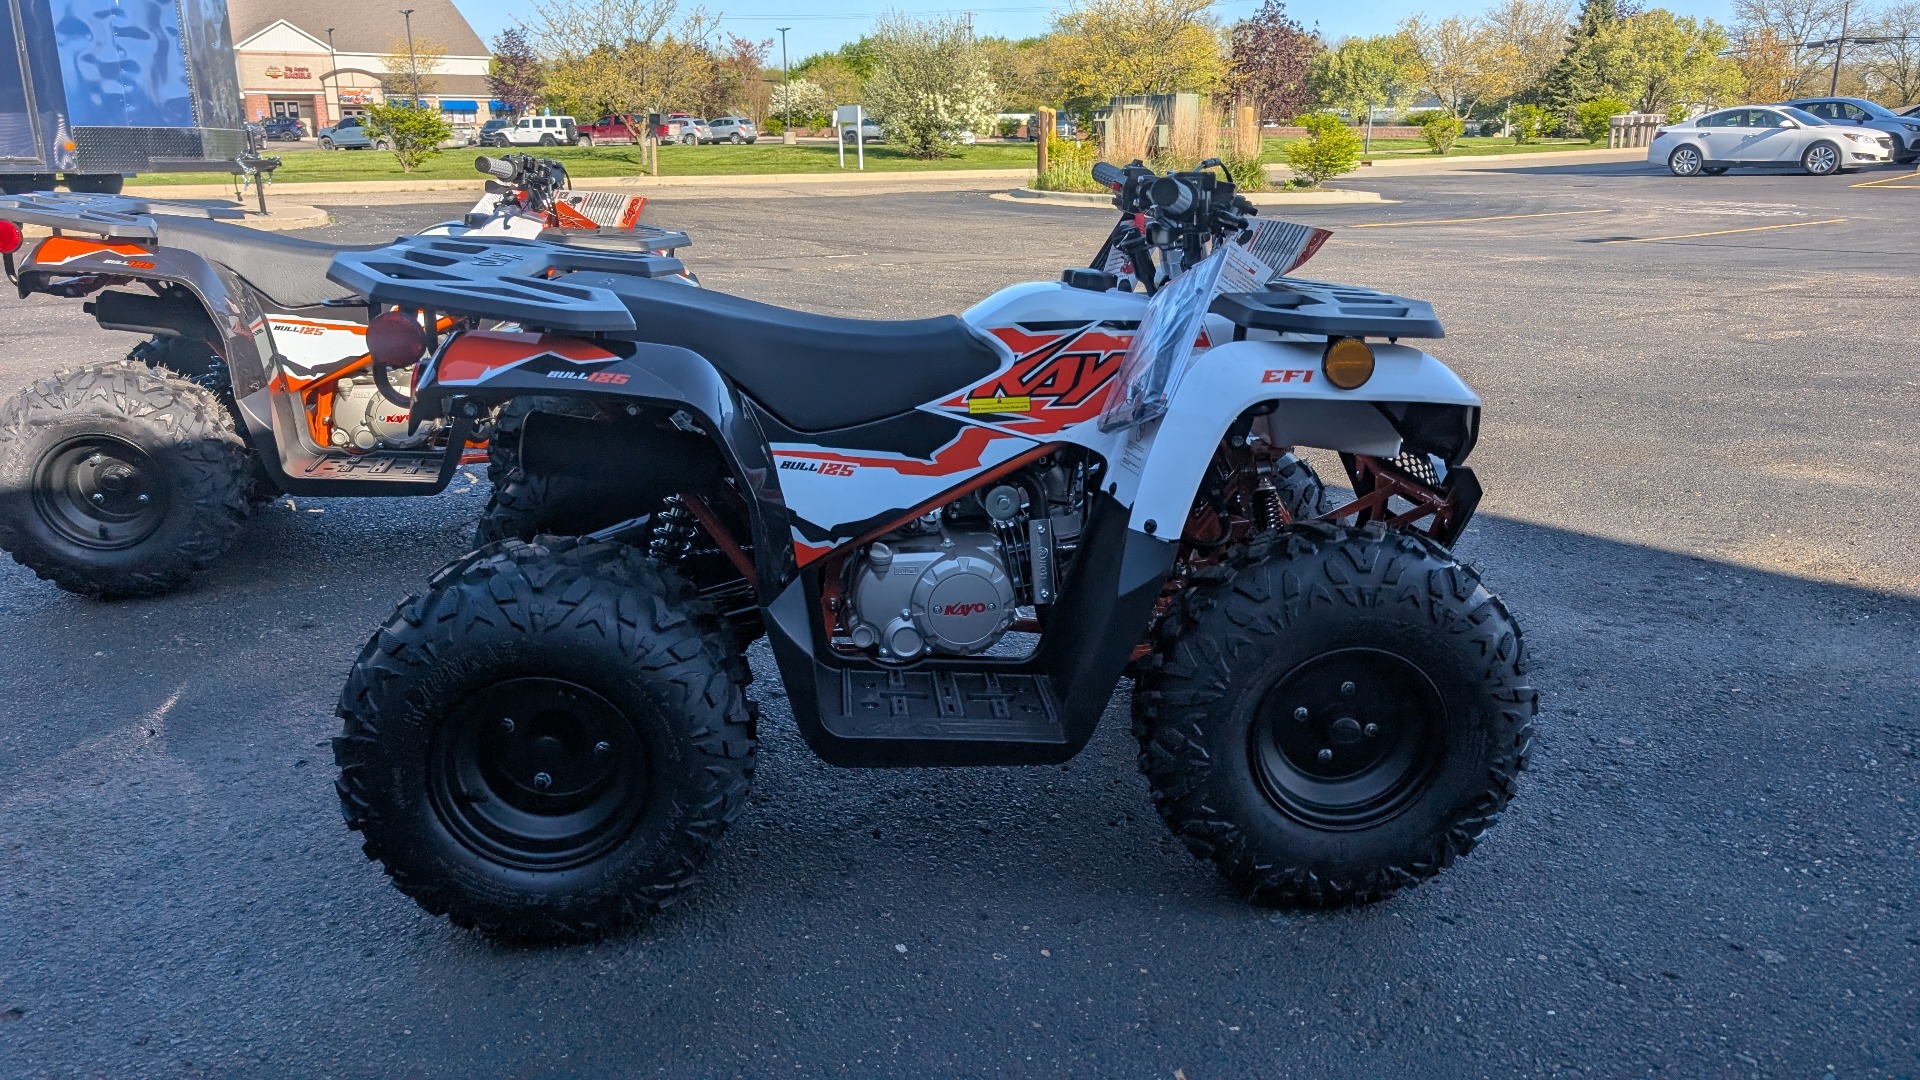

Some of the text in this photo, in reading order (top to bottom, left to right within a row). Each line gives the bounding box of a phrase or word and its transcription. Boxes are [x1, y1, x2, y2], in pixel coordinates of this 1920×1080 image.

[273, 325, 325, 336] BULL125
[966, 325, 1129, 406] KAY
[547, 370, 631, 385] BULL125
[1261, 369, 1314, 383] EFI
[780, 460, 860, 477] BULL125
[943, 602, 987, 618] KAYO
